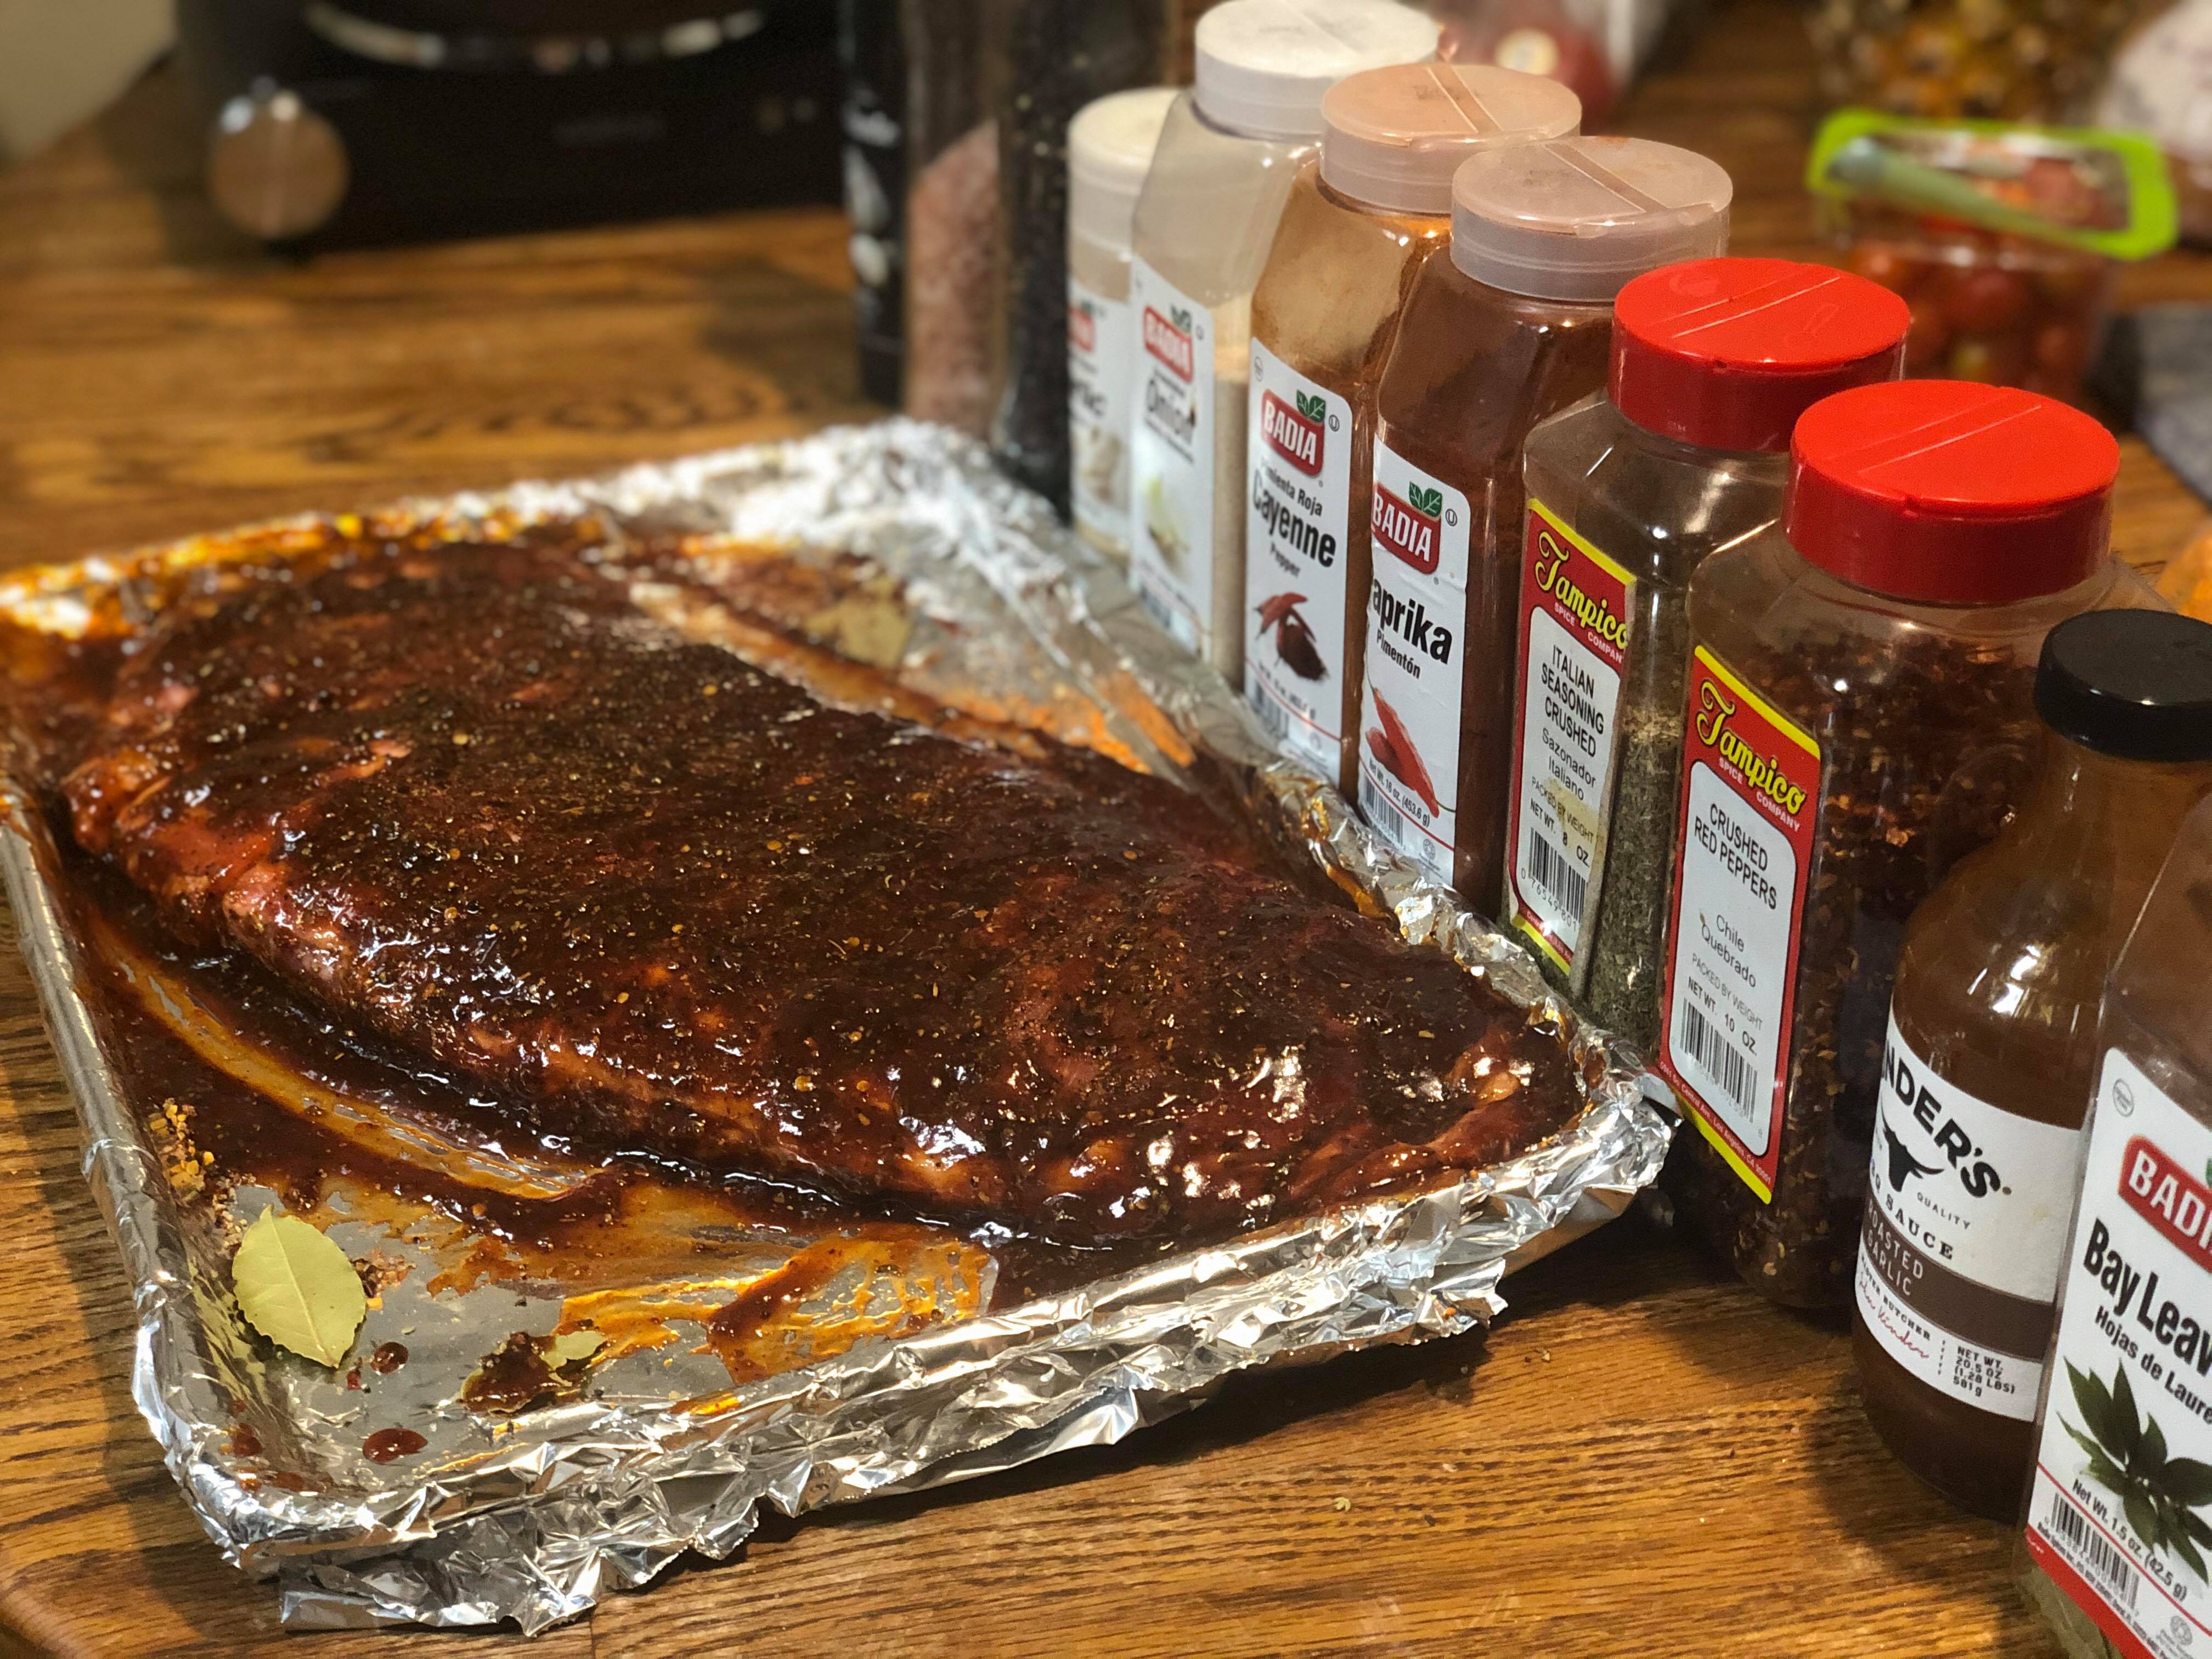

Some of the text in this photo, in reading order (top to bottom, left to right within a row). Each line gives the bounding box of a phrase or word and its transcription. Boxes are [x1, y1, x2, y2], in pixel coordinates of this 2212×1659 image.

[1263, 399, 1317, 466] BADIA
[1252, 469, 1336, 568] Cayenne
[1297, 487, 1323, 517] Roja
[1373, 492, 1432, 562] BADIA
[1535, 531, 1628, 650] Tampico
[1554, 602, 1575, 627] SPICE
[1376, 628, 1421, 680] Pimentón
[1552, 645, 1594, 699] ITALIAN
[1541, 663, 1604, 735] SEASONING
[1544, 696, 1596, 758] CRUSHED
[1542, 727, 1596, 788] Sazonador
[1549, 755, 1584, 800] Italiano
[1696, 680, 1807, 815] Tampico
[1402, 795, 1423, 819] (453.6
[1530, 798, 1543, 820] NET
[1562, 832, 1568, 846] 8
[1532, 776, 1556, 809] PACKED
[1567, 812, 1594, 844] WEIGHT
[1719, 757, 1801, 832] SPICE COMPANY
[1695, 816, 1777, 910] RED PEPPERS
[1710, 803, 1768, 871] CRUSHED
[1701, 923, 1757, 988] Quebrado
[1716, 914, 1745, 953] Chile
[1688, 975, 1703, 999] NET
[1725, 1013, 1735, 1032] 10
[1692, 952, 1763, 1031] PACKED BY WEIGHT
[1886, 1193, 1953, 1260] SAUCE
[1916, 1192, 1971, 1230] QUALITY
[2128, 1148, 2212, 1255] BADI
[1868, 1229, 1912, 1296] GARLIC
[1869, 1199, 1923, 1279] ROASTED
[2083, 1217, 2142, 1317] Bay
[1883, 1294, 1931, 1341] BUTCHER
[2095, 1305, 2138, 1359] Hojas
[2141, 1353, 2163, 1380] de
[1956, 1356, 1982, 1373] 20.5
[1957, 1346, 1979, 1362] NET
[2072, 1477, 2091, 1505] Net
[2112, 1517, 2128, 1541] 1.5
[2145, 1551, 2174, 1587] (42.5
[2172, 1583, 2187, 1602] g)
